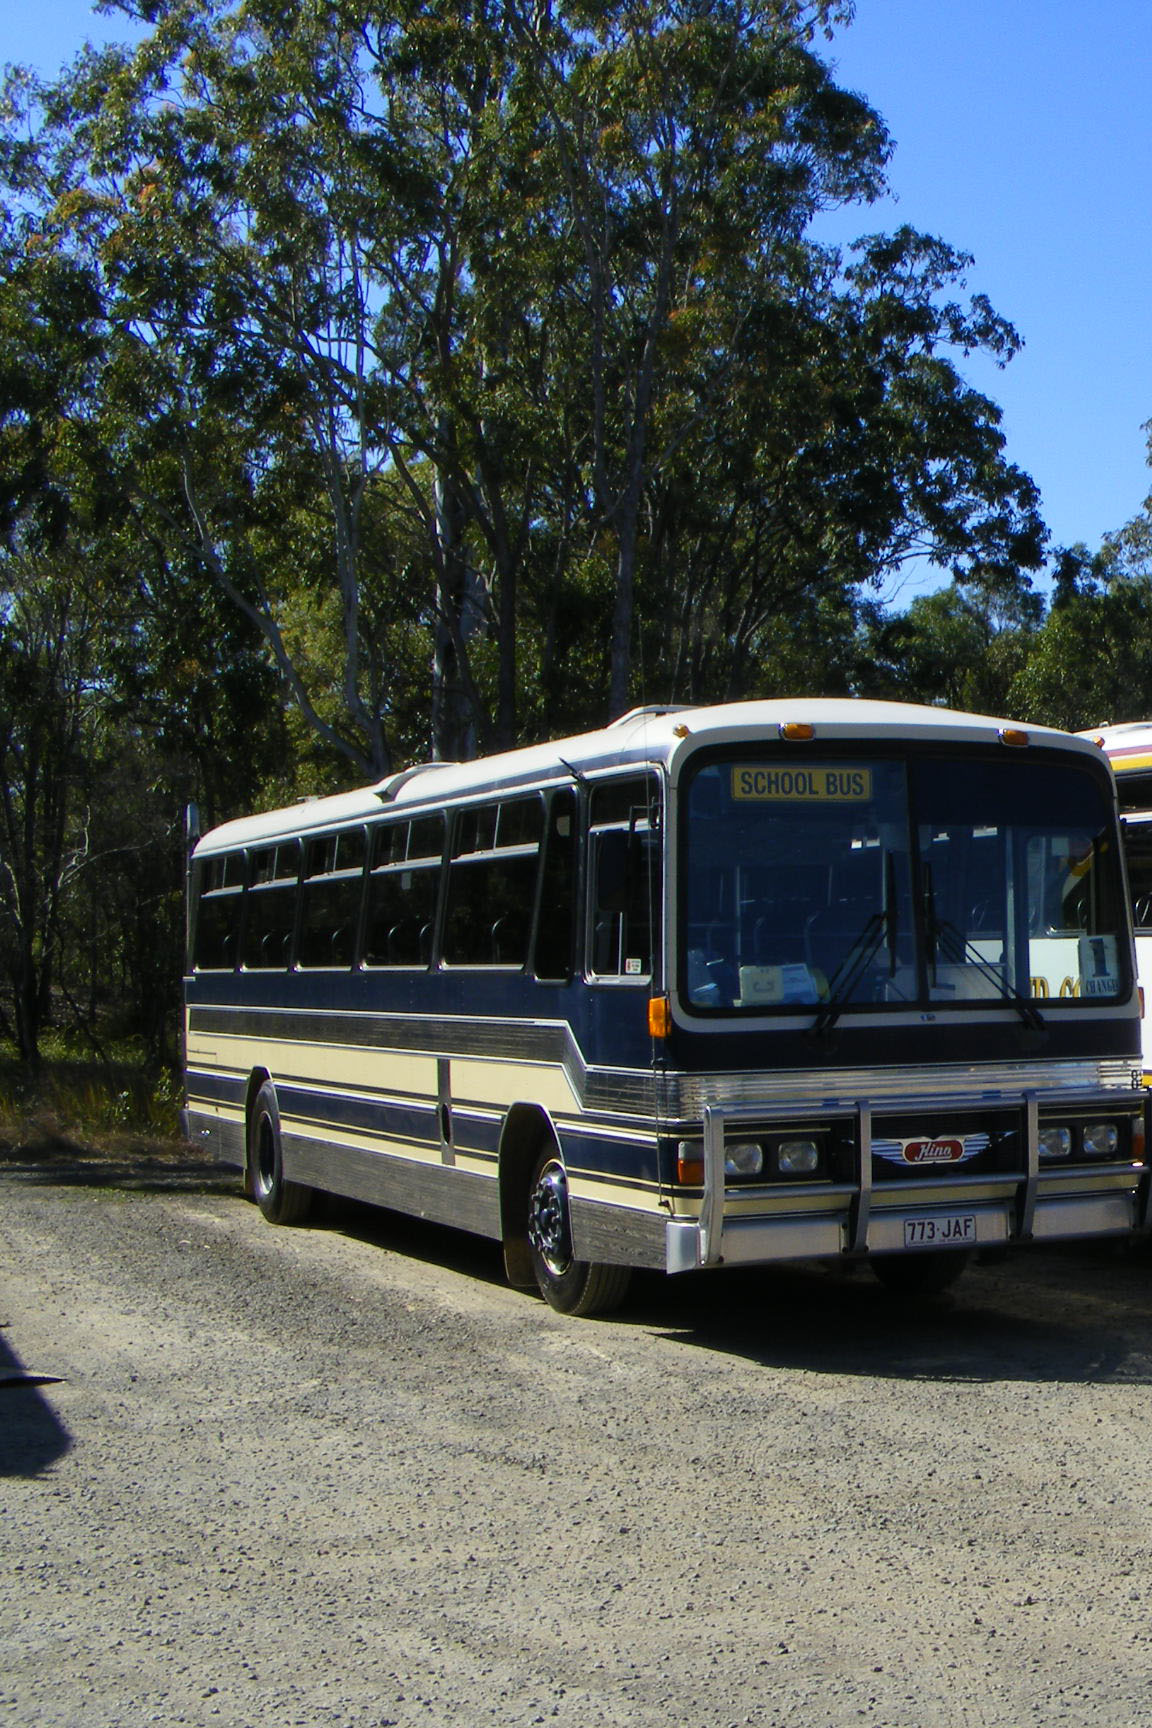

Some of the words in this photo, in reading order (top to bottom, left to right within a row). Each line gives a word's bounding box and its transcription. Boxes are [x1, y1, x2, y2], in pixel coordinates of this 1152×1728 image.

[740, 771, 819, 795] SCHOOL
[826, 772, 864, 795] BUS
[914, 1141, 952, 1161] Hino
